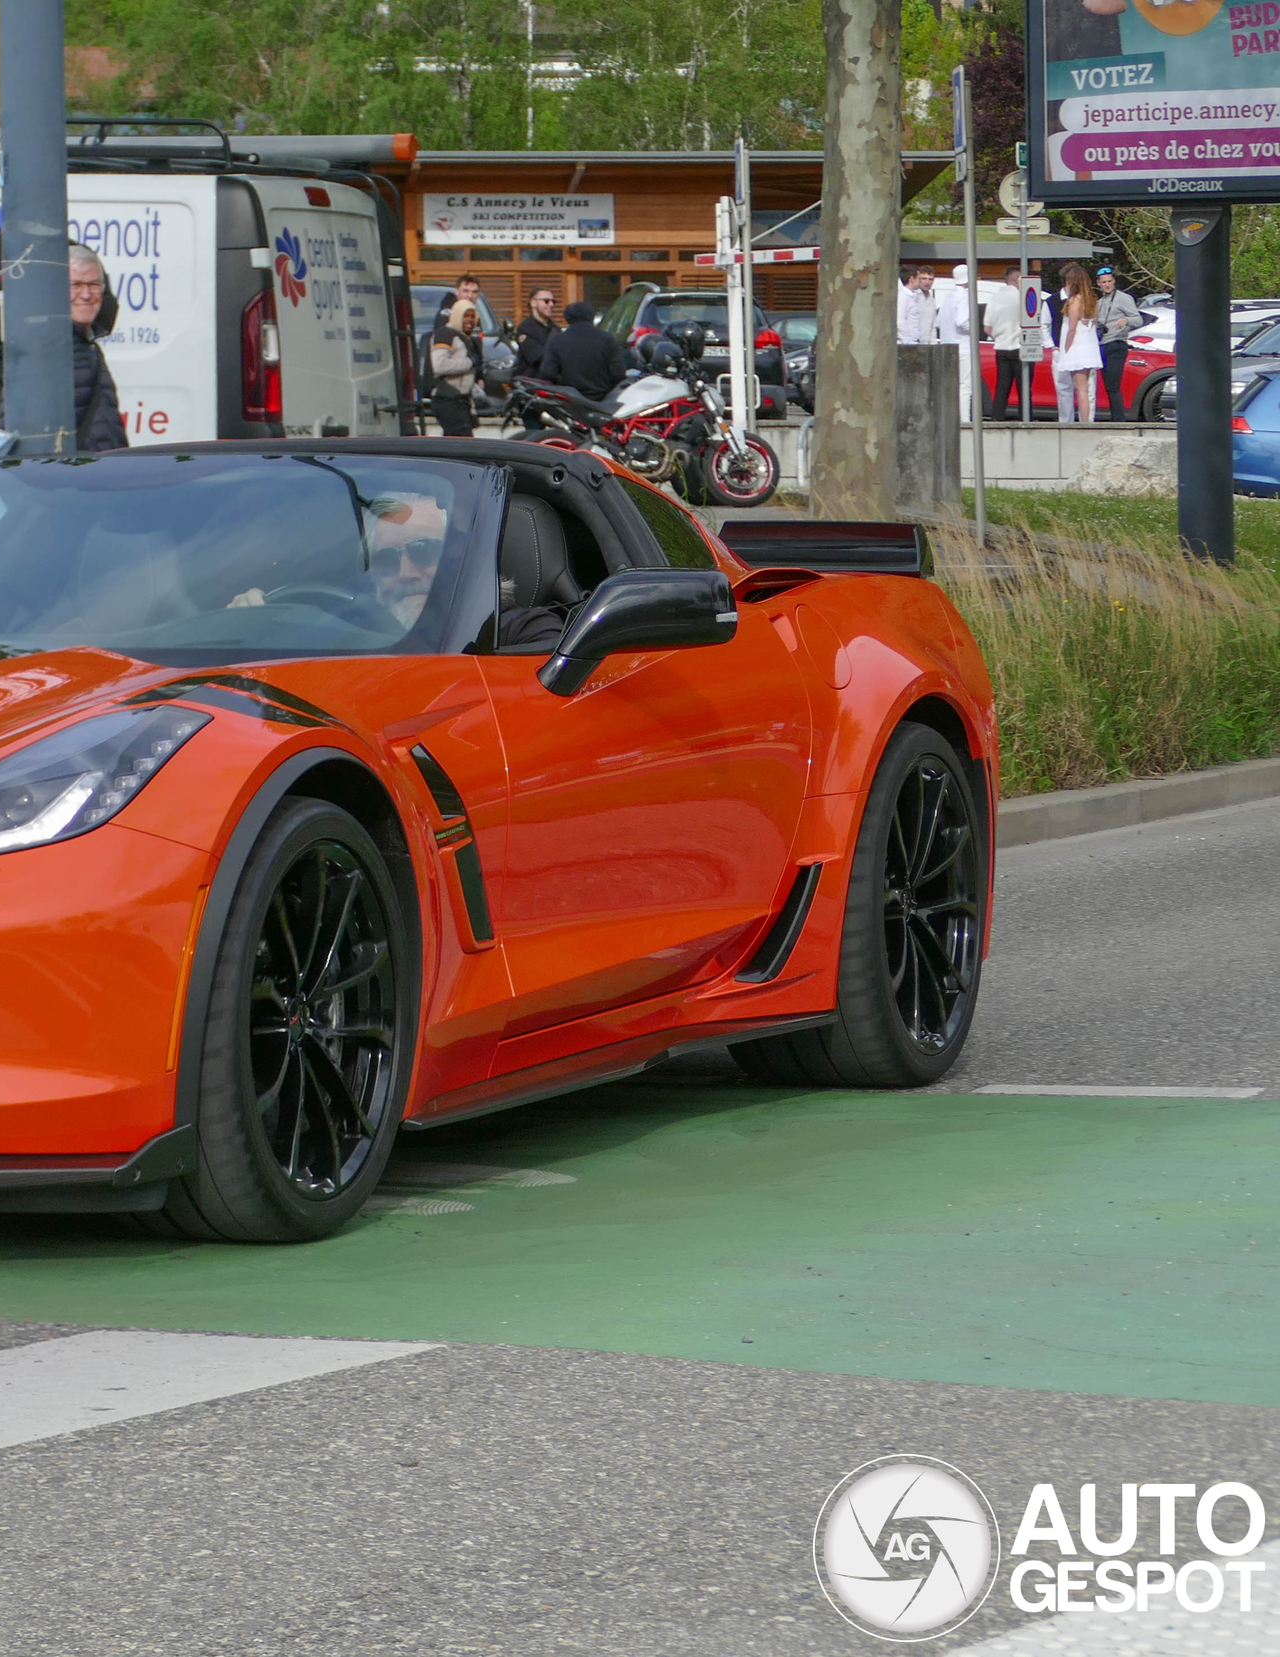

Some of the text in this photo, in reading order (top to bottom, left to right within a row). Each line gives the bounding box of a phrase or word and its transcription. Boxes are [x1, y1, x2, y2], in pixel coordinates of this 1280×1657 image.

[1231, 28, 1280, 57] PAR
[1071, 63, 1154, 90] VOTEZ
[1084, 148, 1111, 163] ou
[1115, 141, 1160, 165] près
[1165, 140, 1189, 160] de
[1194, 139, 1244, 159] chez
[1147, 178, 1223, 193] JCDecaux
[474, 196, 527, 210] Annecy
[532, 196, 545, 207] le
[551, 196, 591, 207] Vieux
[130, 327, 160, 344] 1926
